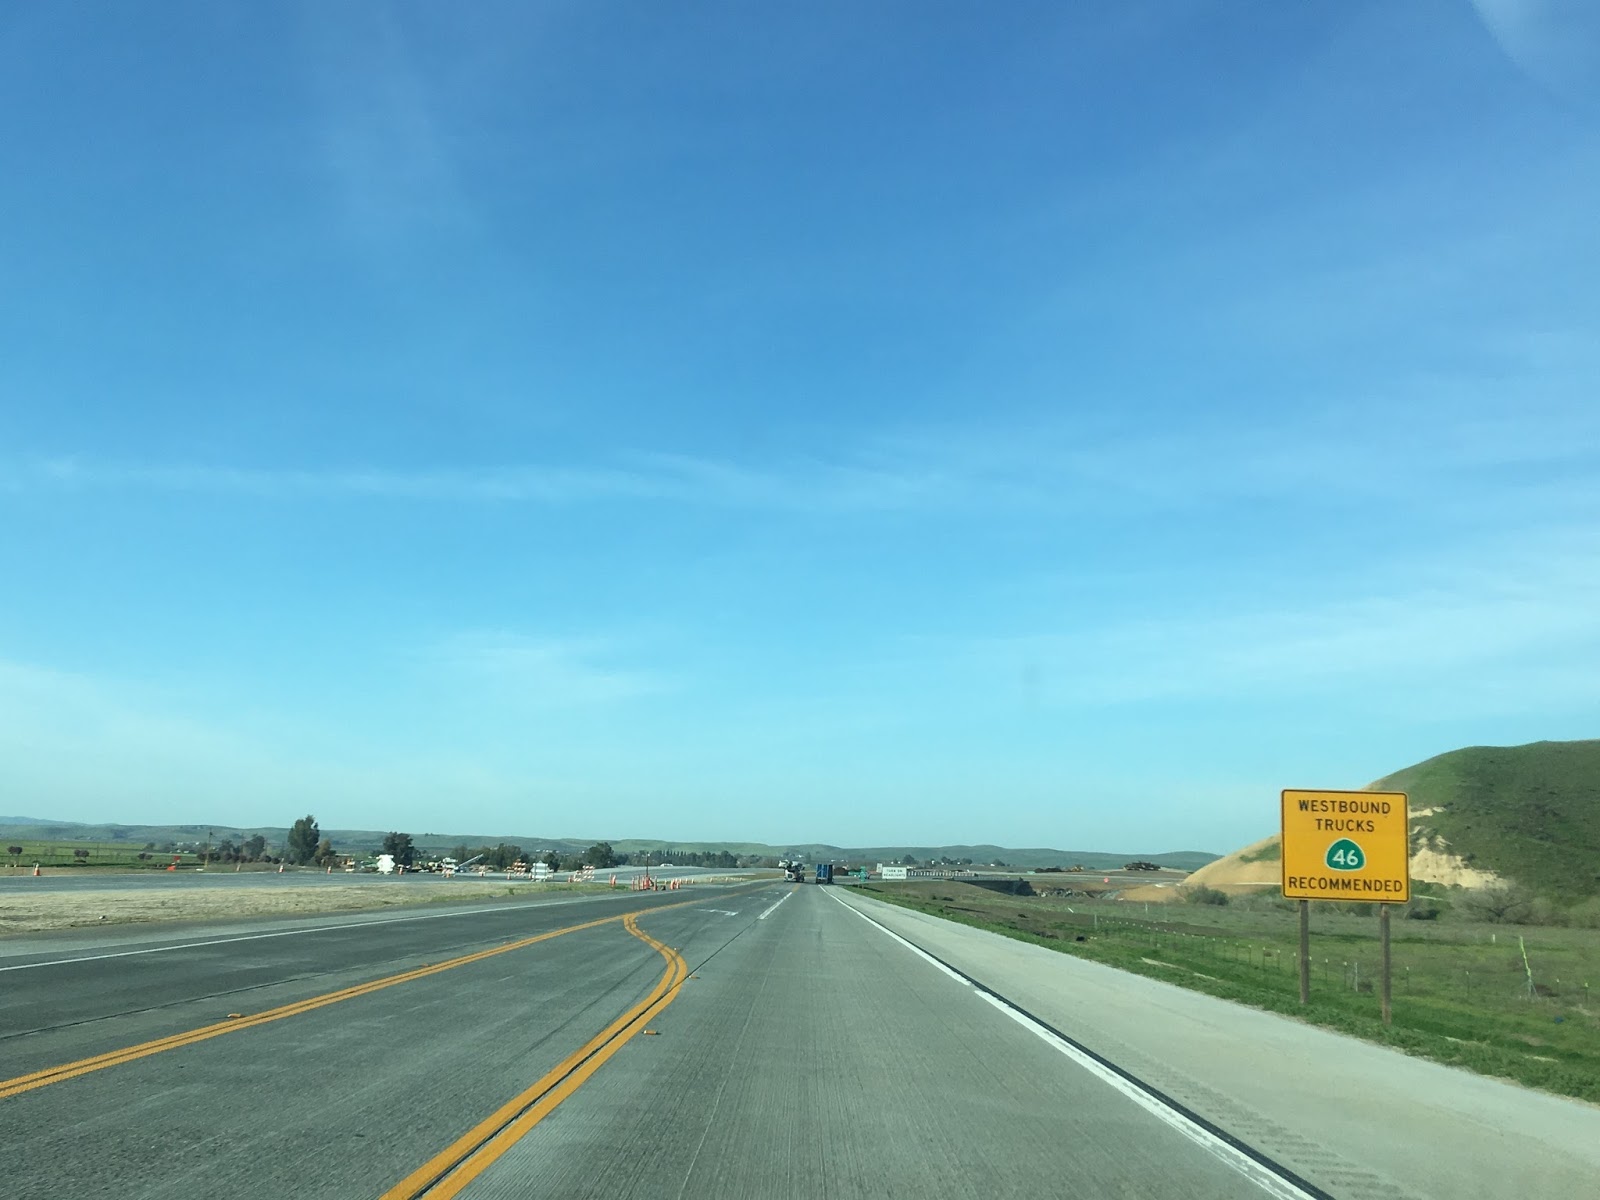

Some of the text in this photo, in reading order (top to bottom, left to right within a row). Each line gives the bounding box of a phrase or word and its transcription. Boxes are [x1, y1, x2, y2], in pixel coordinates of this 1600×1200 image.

[1299, 800, 1391, 814] WESTBOUND
[1316, 819, 1375, 832] TRUCKS
[1332, 849, 1359, 866] 46
[1288, 877, 1403, 892] RECOMMENDED
